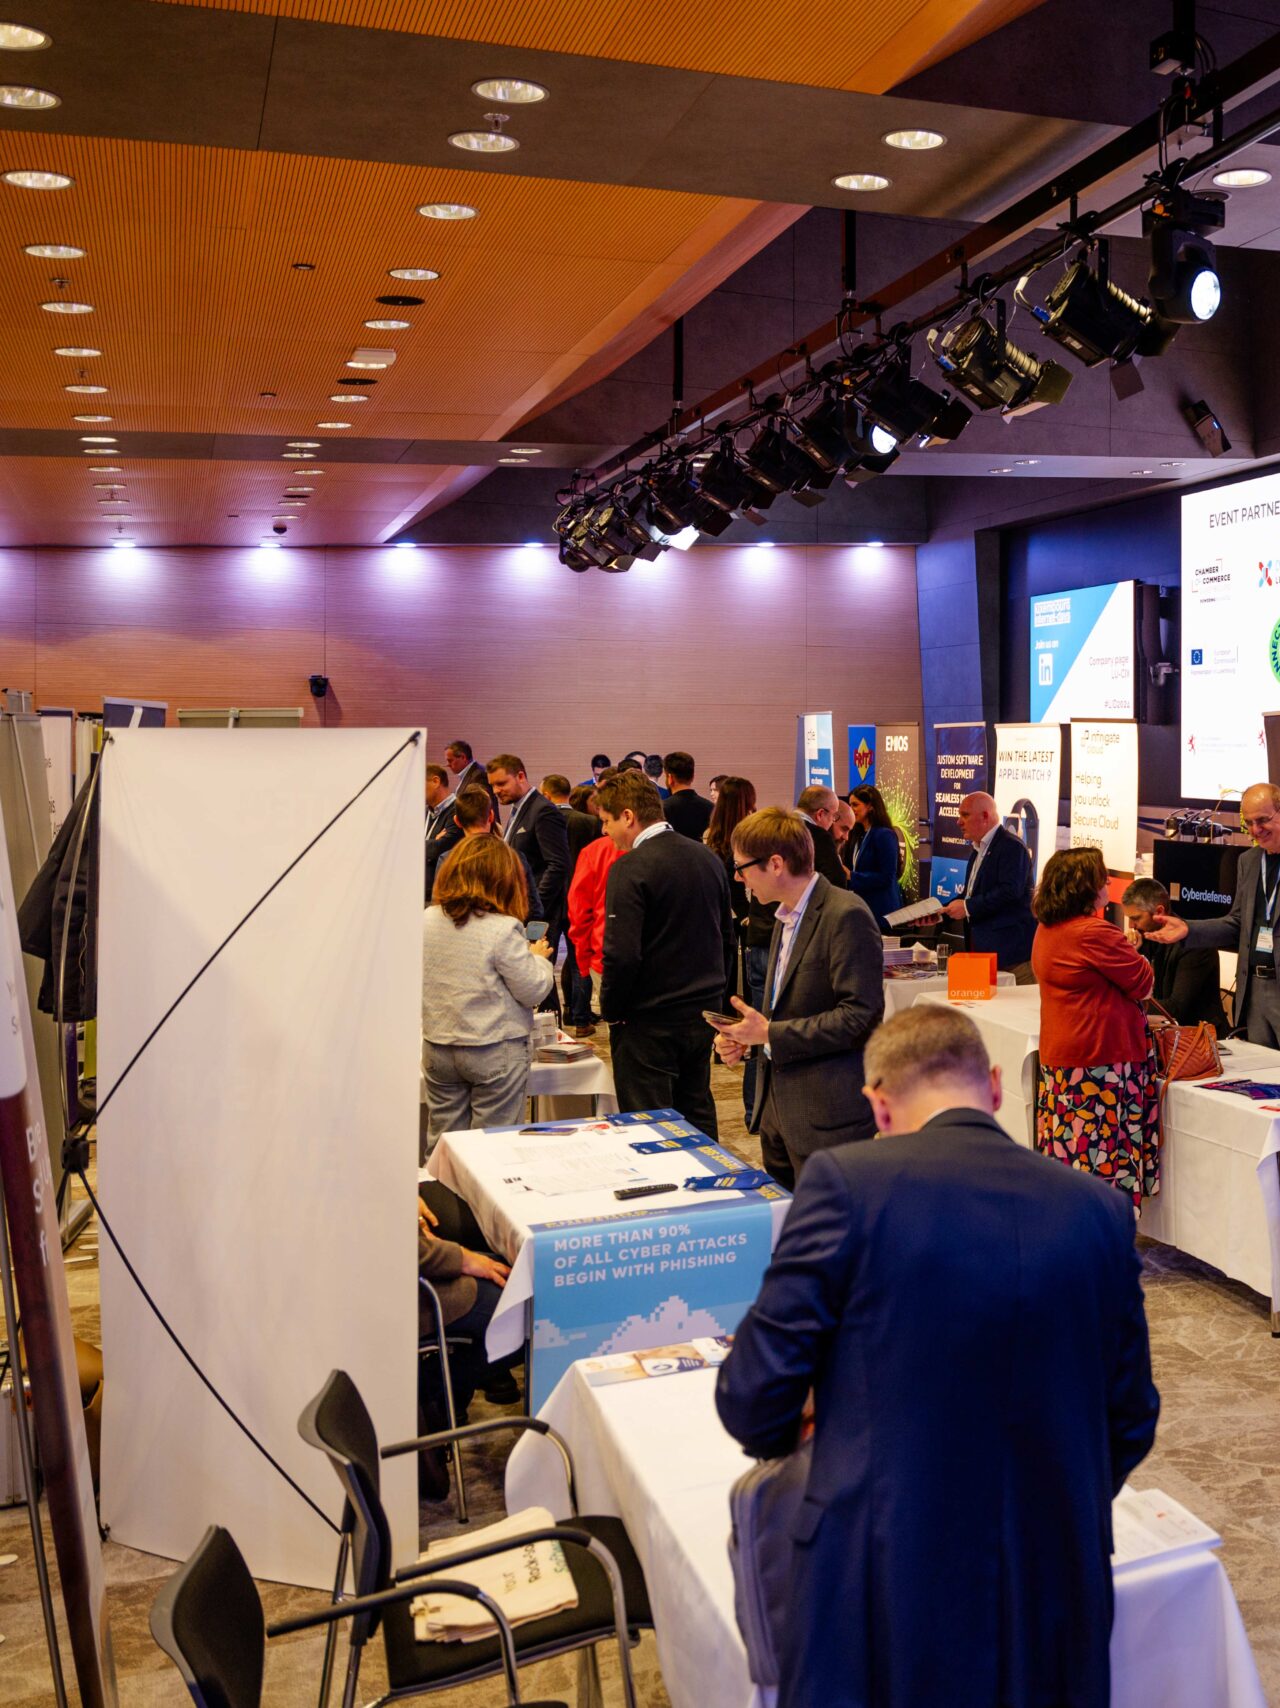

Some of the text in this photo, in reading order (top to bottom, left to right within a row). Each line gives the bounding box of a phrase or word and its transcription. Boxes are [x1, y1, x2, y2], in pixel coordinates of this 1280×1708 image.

[1209, 508, 1239, 529] EVENT
[1195, 566, 1219, 576] CHAMBER
[1202, 574, 1231, 585] COMMERCE
[1040, 658, 1051, 682] in
[956, 754, 984, 767] SOFTWARE
[998, 750, 1055, 763] WIN THE LATEST
[940, 768, 976, 780] DEVELOPMENT
[998, 768, 1019, 781] APPLE
[1021, 769, 1045, 781] WATCH
[1075, 772, 1102, 789] Helping
[1074, 792, 1111, 807] you unlock
[1073, 811, 1119, 831] Secure Cloud
[1181, 886, 1232, 905] Cyberdefense
[950, 989, 985, 999] orange
[553, 1223, 691, 1252] MORE THAN 90%
[553, 1233, 748, 1270] OF ALL CYBER ATTACKS
[553, 1251, 737, 1288] BEGIN WITH PHISHING
